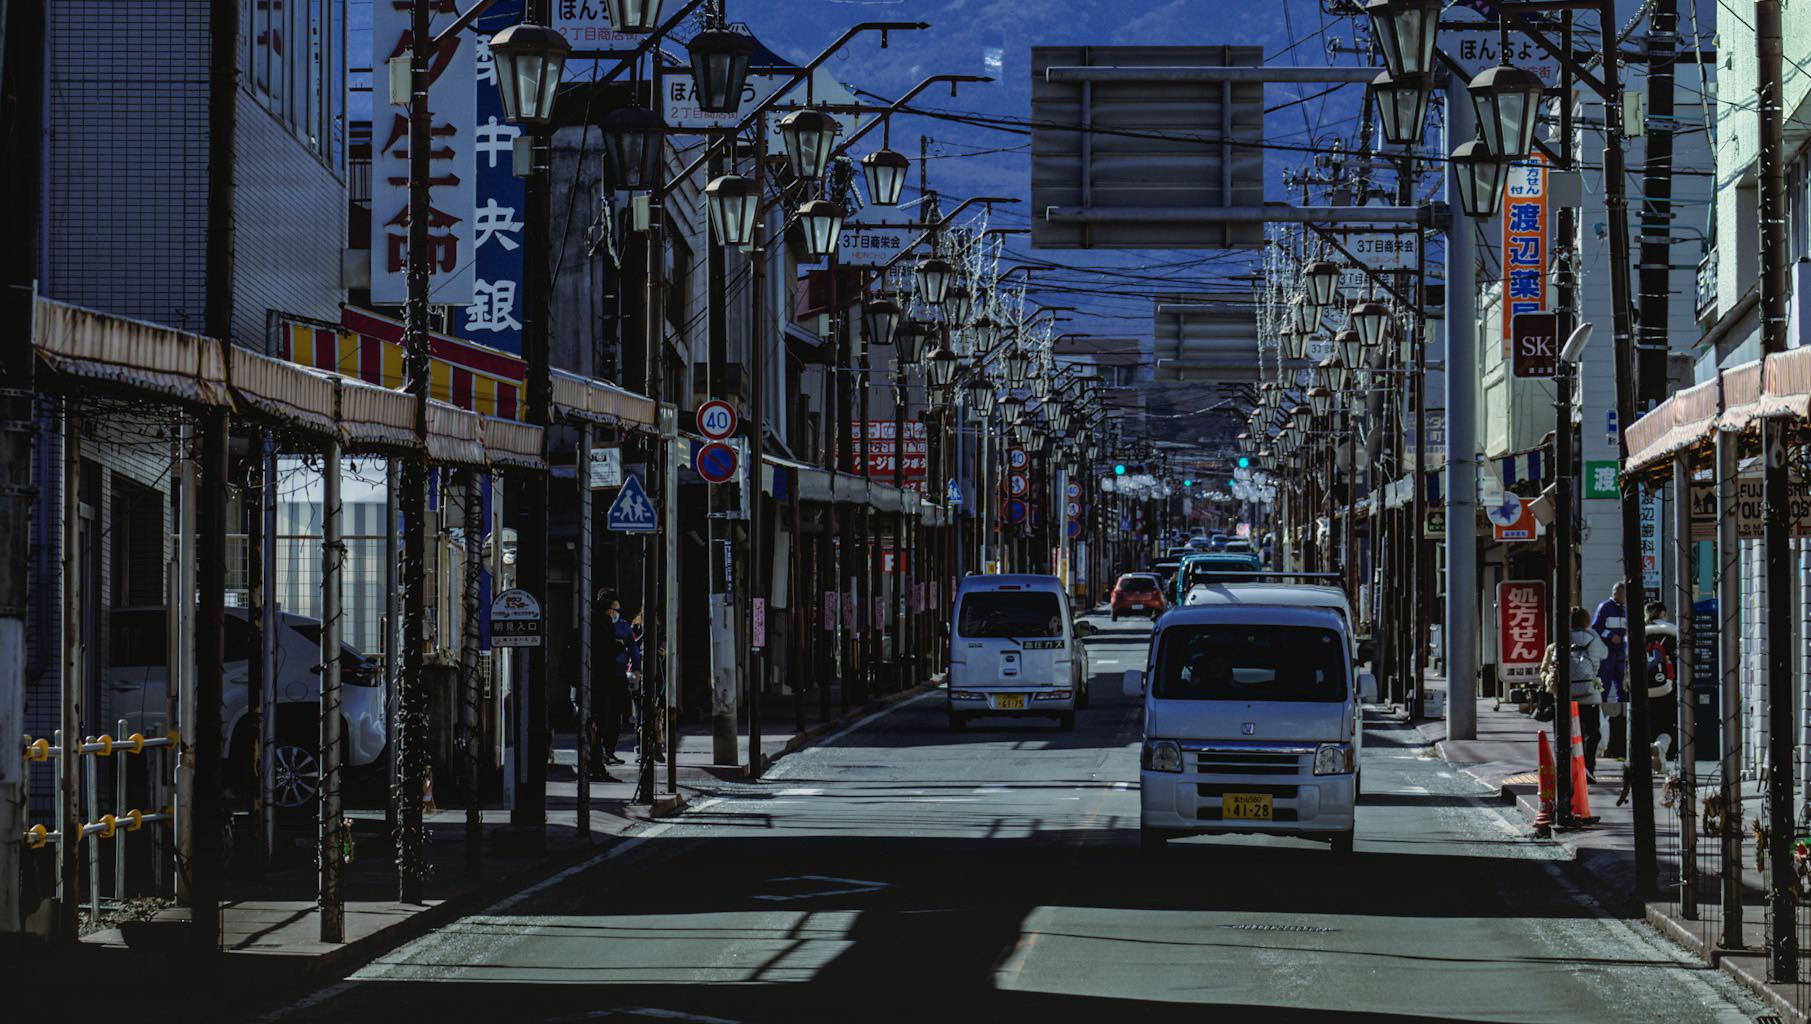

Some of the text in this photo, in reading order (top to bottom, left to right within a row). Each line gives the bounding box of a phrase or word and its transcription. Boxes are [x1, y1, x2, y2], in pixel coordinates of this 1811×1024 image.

[1521, 335, 1553, 357] SK
[707, 411, 728, 430] 40
[1011, 453, 1024, 465] 40
[1507, 587, 1539, 660] 処方せん
[1233, 804, 1270, 818] 41-28
